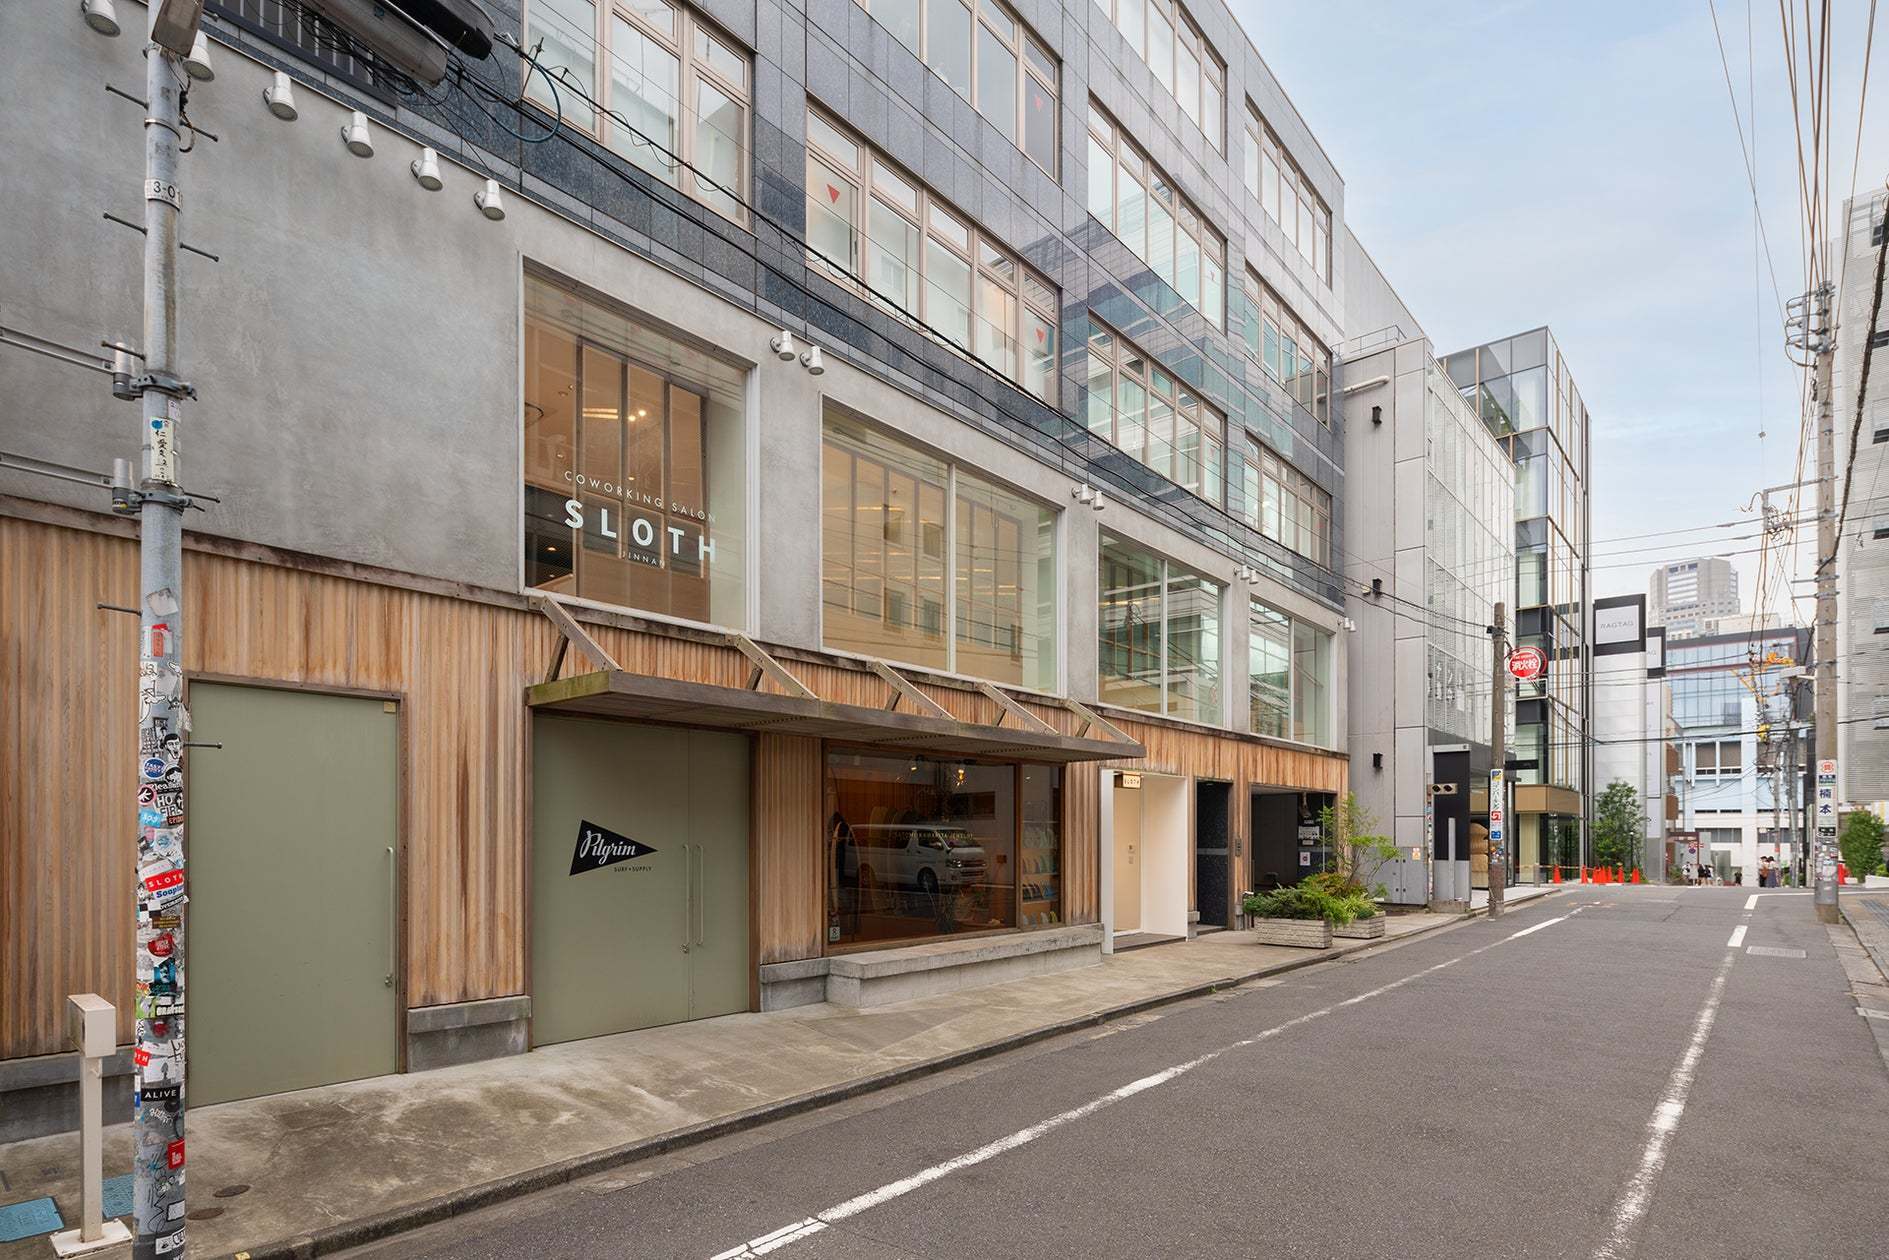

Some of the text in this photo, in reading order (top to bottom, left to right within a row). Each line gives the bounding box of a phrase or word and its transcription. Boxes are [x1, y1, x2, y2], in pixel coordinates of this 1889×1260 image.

[564, 470, 716, 523] COWORKING SALON
[564, 499, 716, 563] SLOTH
[622, 550, 665, 568] JINNAN
[1600, 620, 1634, 629] RAGTAG
[1511, 658, 1538, 671] 消火栓
[579, 829, 636, 865] Pilgrim
[144, 1089, 177, 1099] ALIVE
